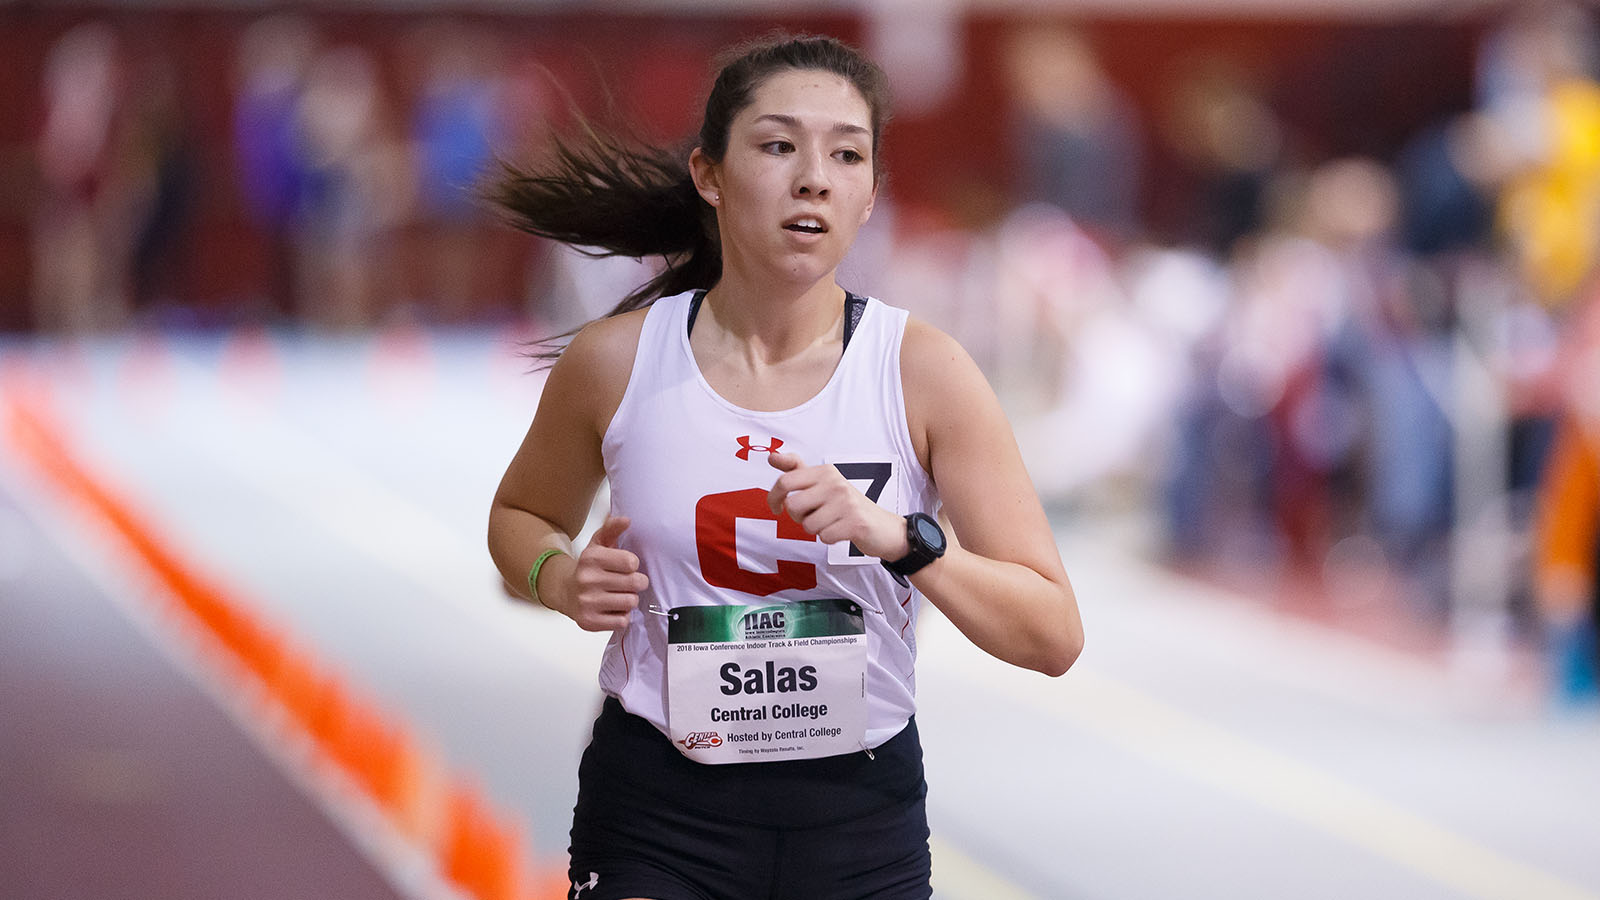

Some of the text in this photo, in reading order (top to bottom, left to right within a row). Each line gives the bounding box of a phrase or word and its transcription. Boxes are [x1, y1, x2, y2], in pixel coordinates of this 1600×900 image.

[833, 462, 892, 557] 7
[693, 644, 709, 652] Iowa
[710, 643, 745, 651] Conference
[768, 640, 787, 648] Track
[794, 639, 809, 647] Field
[810, 636, 858, 646] Championships
[719, 660, 818, 696] Salas
[710, 703, 828, 722] Central College
[727, 726, 842, 743] Hosted by Central College
